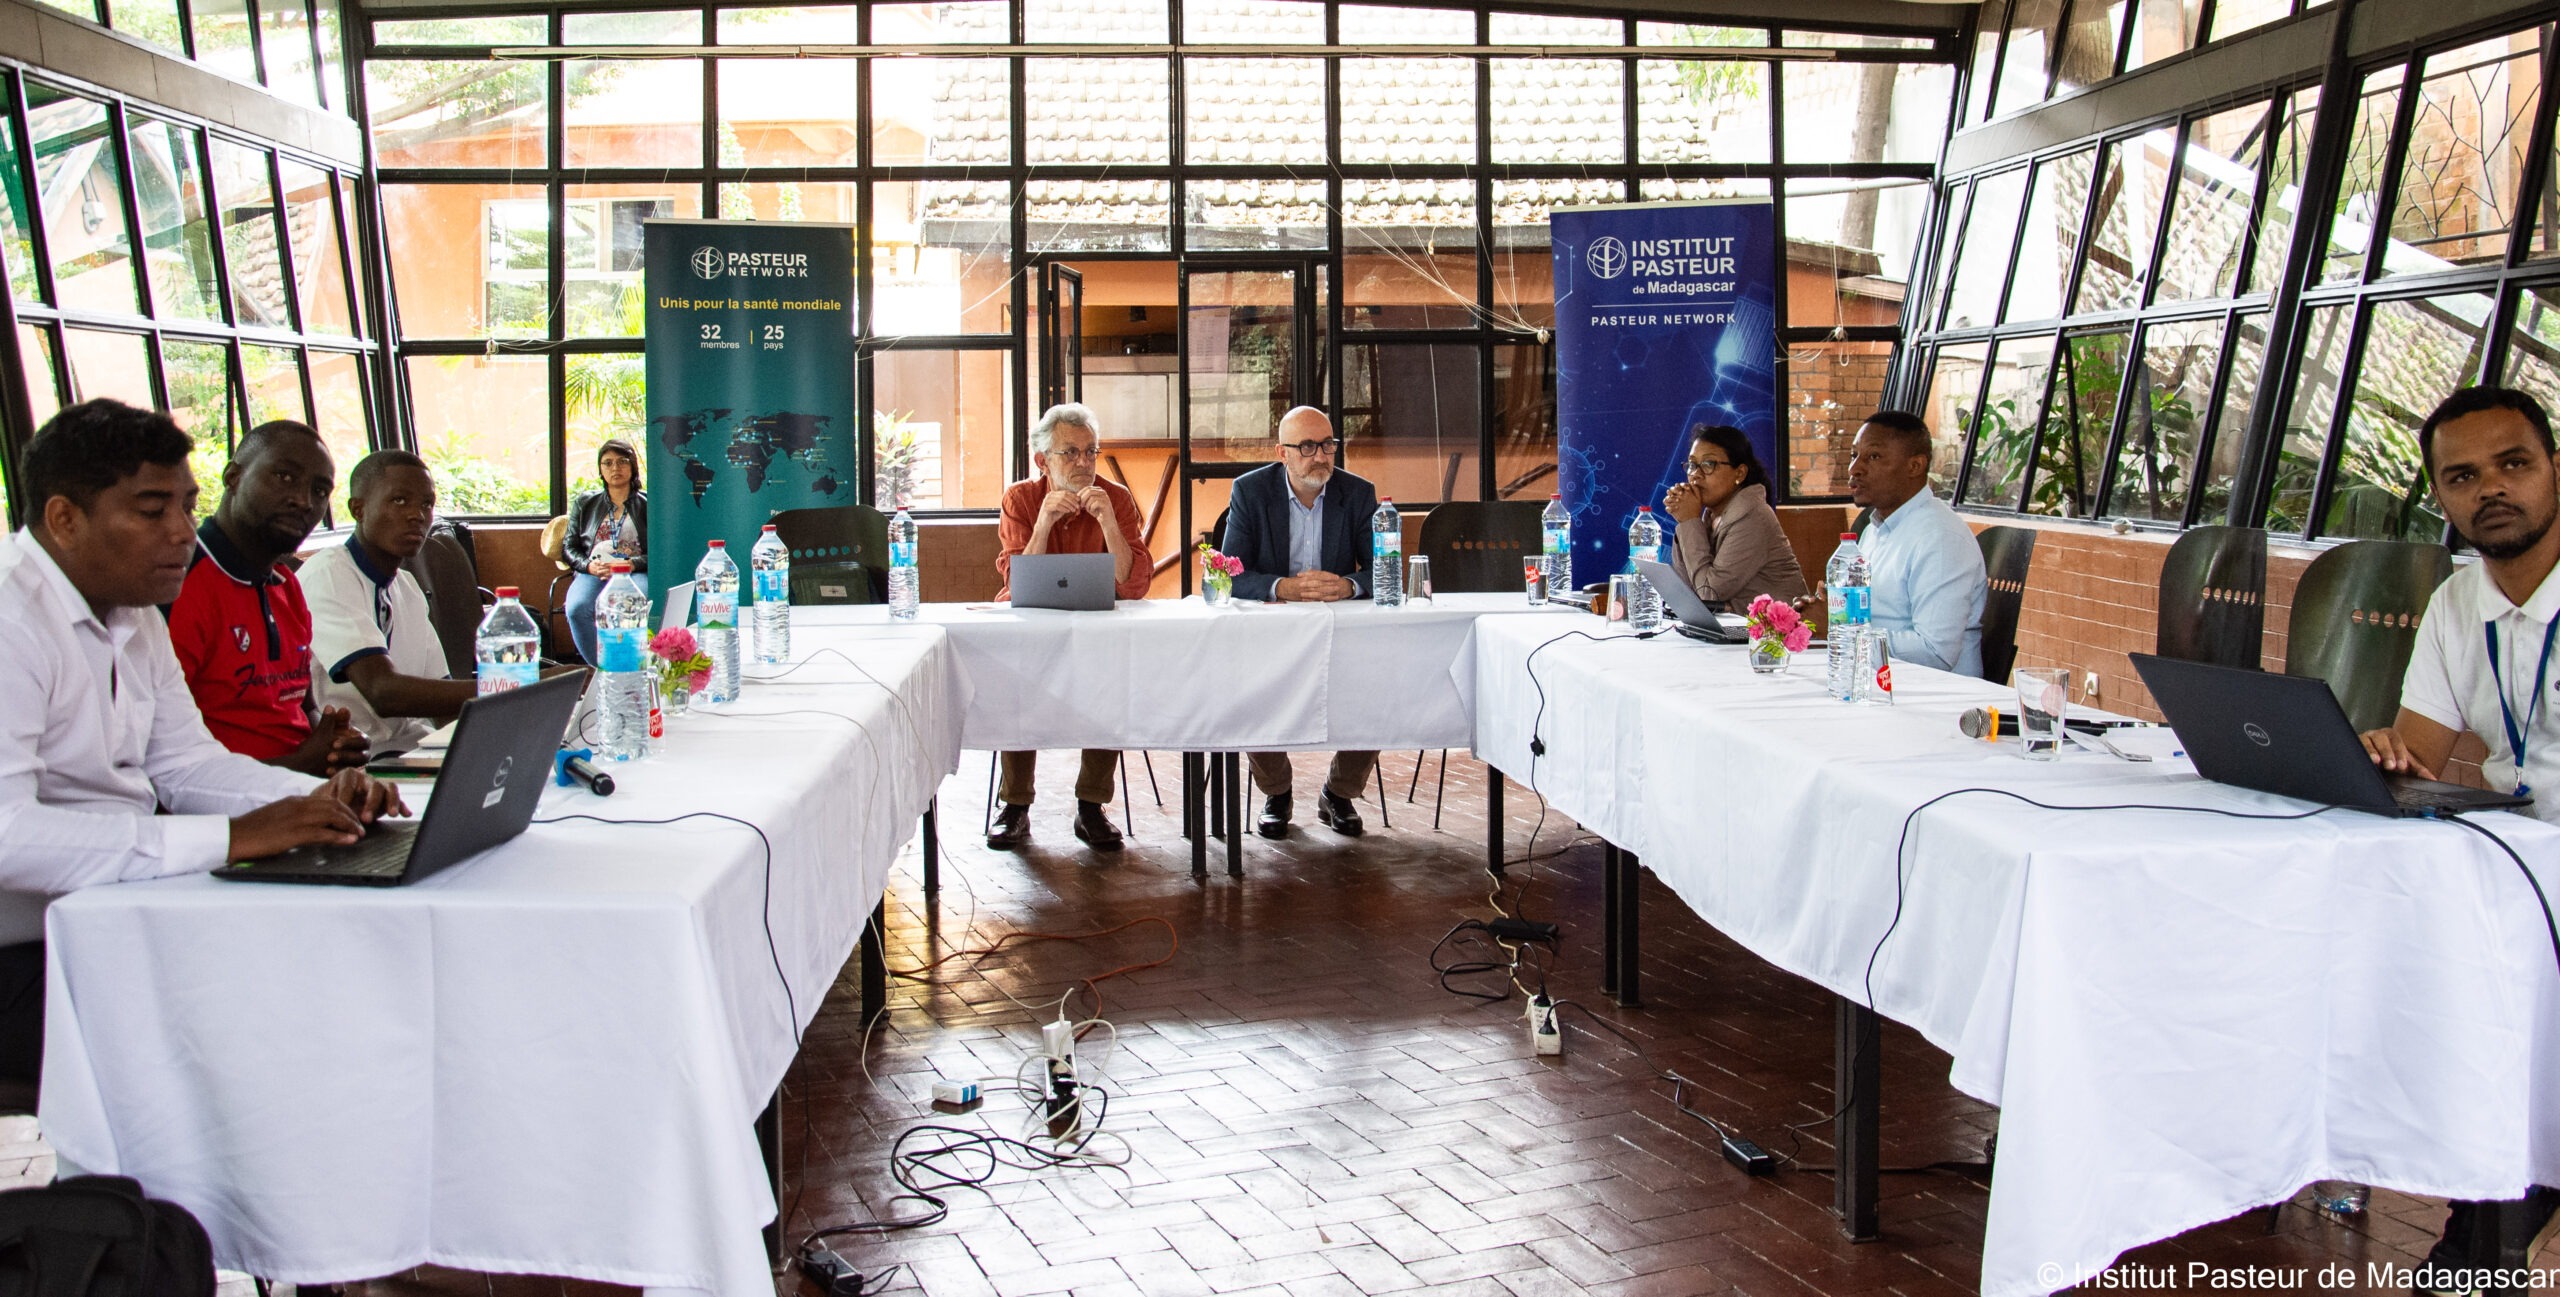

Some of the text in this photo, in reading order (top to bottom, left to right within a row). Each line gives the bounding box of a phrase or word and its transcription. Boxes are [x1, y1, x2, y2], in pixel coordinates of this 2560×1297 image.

[1632, 237, 1735, 257] INSTITUT
[728, 253, 808, 266] PASTEUR
[728, 267, 808, 278] NETWORK
[1632, 257, 1736, 277] PASTEUR
[1632, 280, 1736, 295] de Madagascar
[659, 297, 842, 311] Unis pour la santé mondiale
[1591, 313, 1736, 326] PASTEUR NETWORK
[700, 324, 785, 340] 32 25
[700, 341, 784, 351] membres pays
